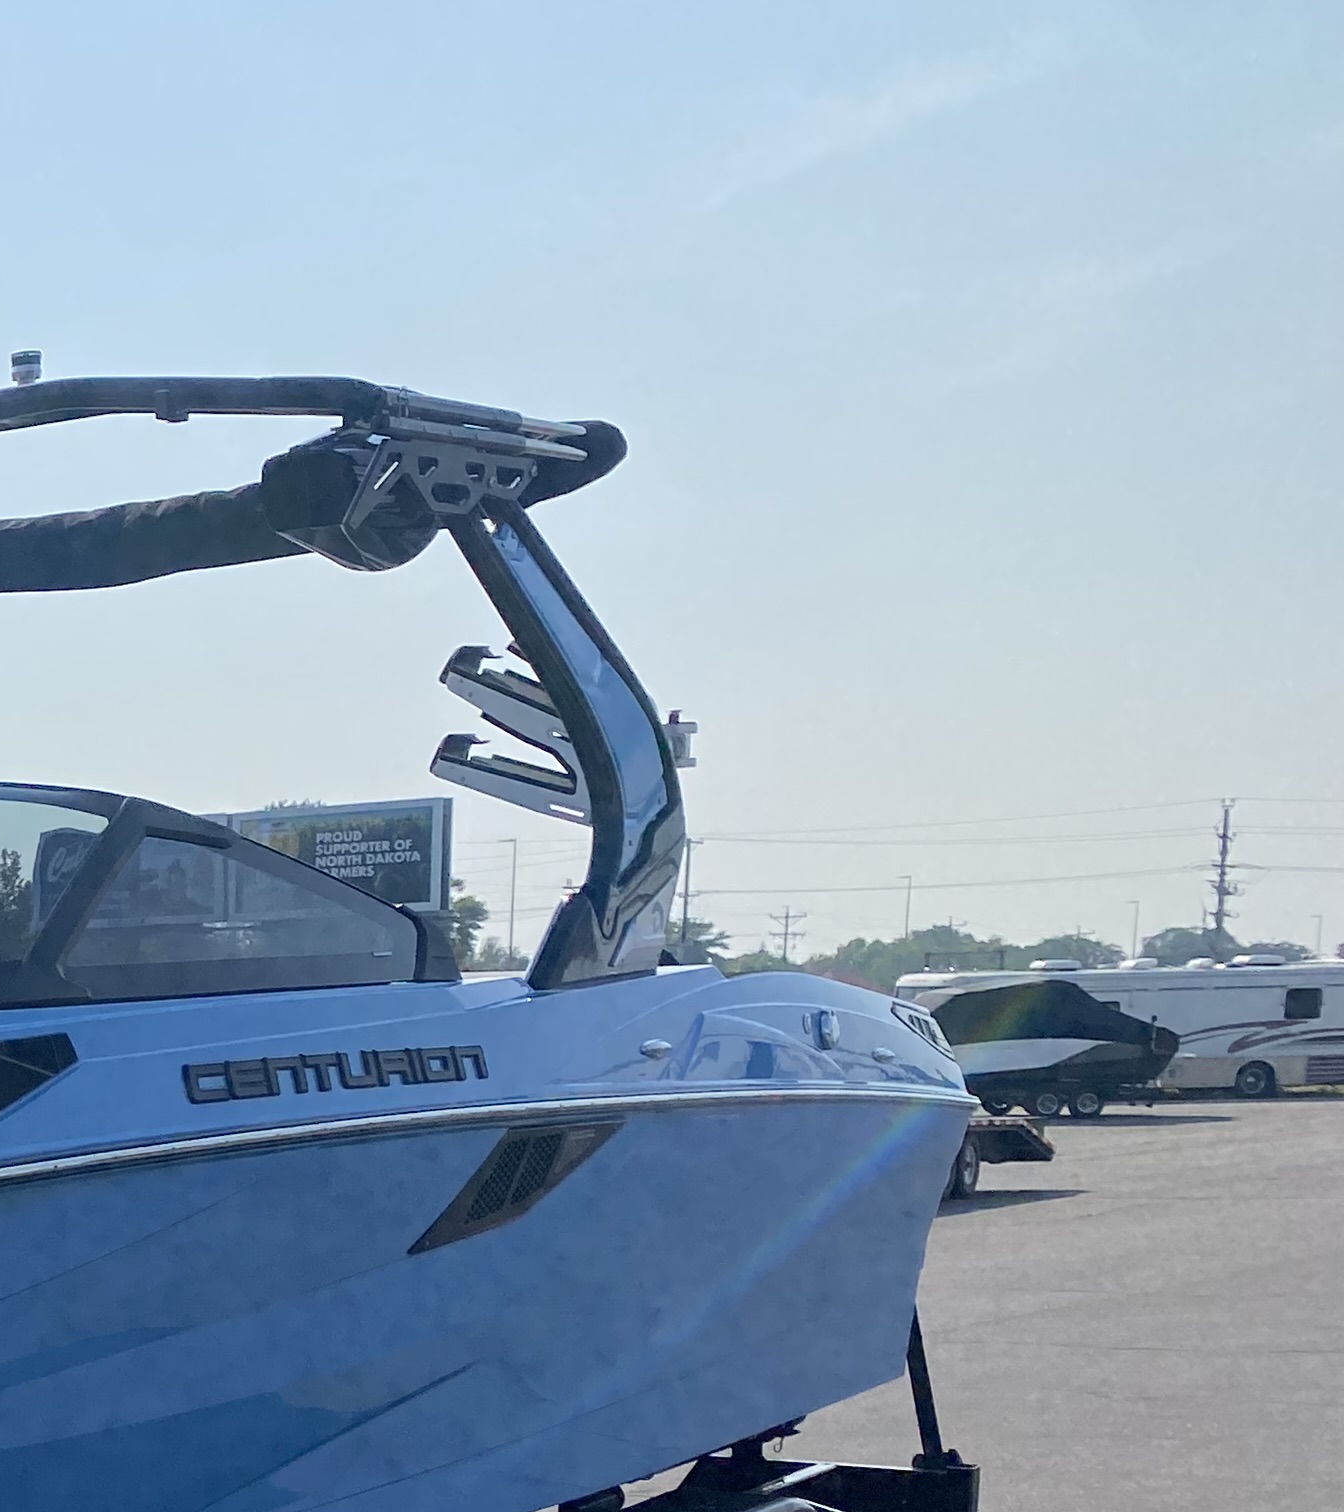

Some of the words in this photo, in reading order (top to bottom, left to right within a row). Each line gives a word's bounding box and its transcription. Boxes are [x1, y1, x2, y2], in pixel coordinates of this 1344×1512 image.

[316, 831, 362, 843] PROUD
[315, 841, 390, 855] SUPPORTER
[394, 839, 412, 850] OF
[315, 854, 361, 867] NORTH
[366, 851, 421, 864] DAKOTA
[182, 1045, 489, 1104] CENTURION
